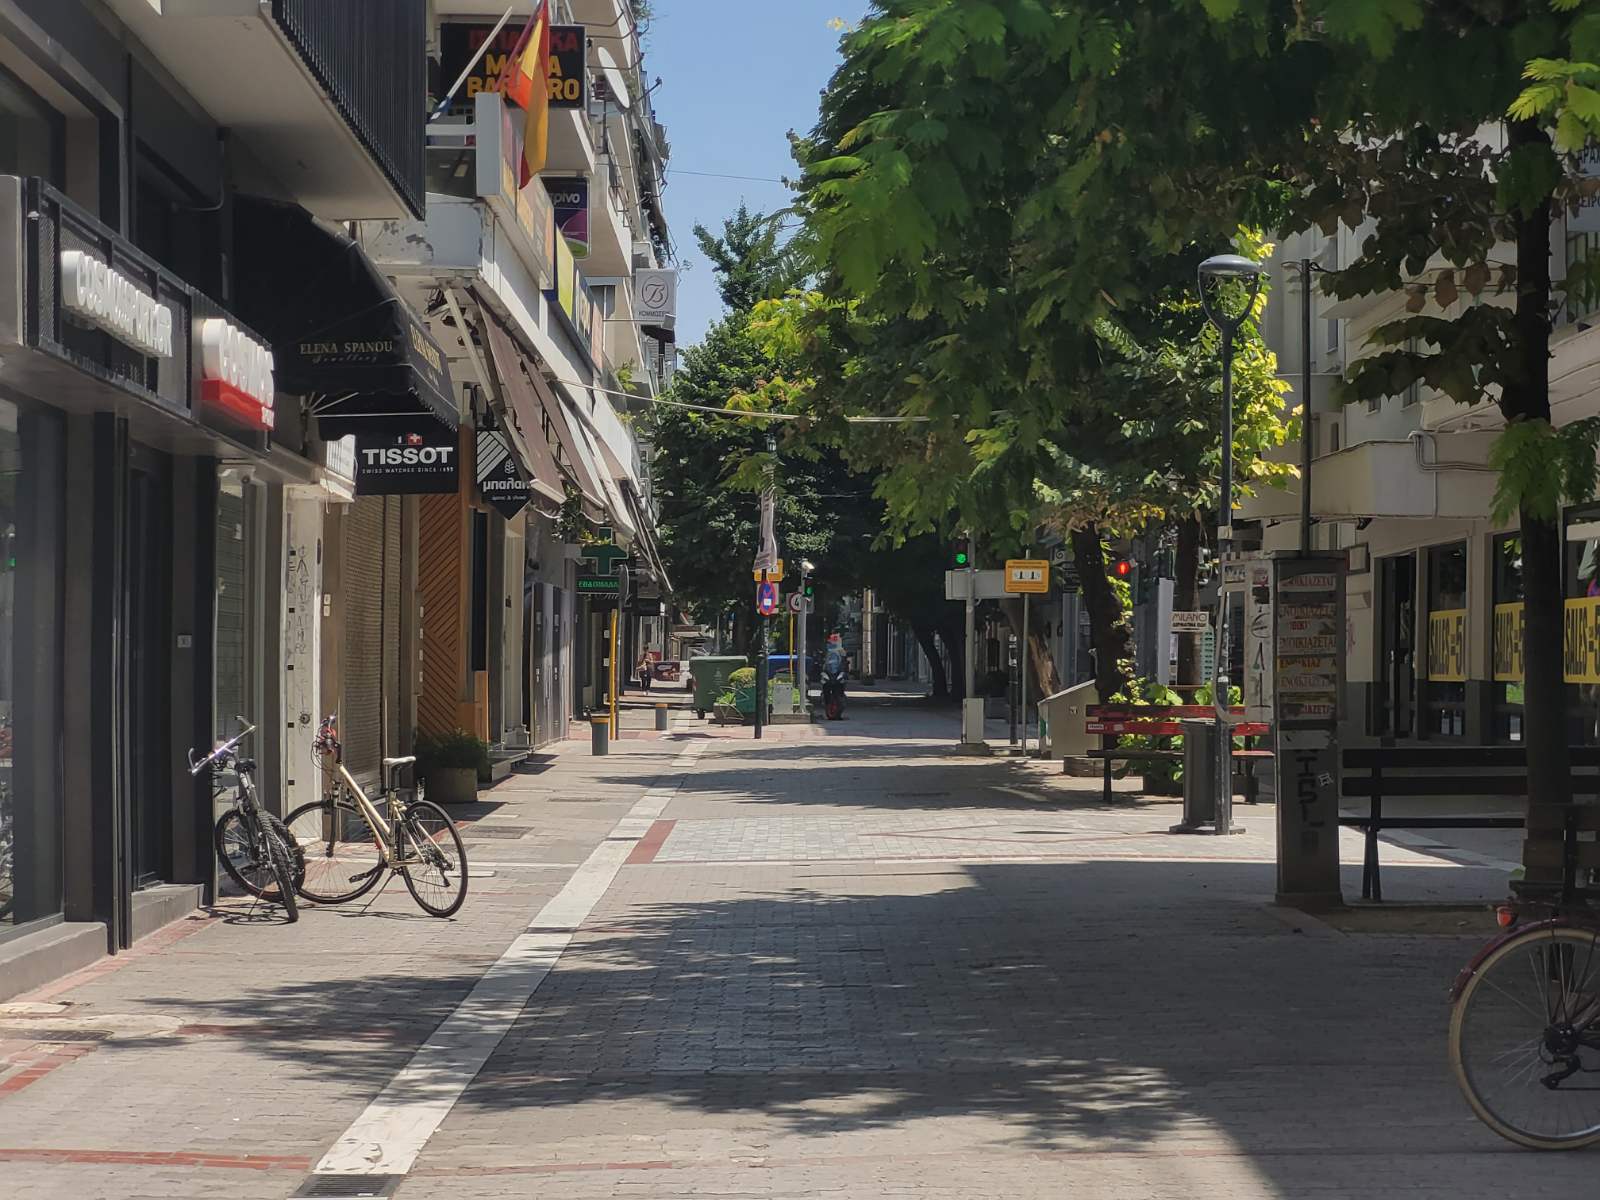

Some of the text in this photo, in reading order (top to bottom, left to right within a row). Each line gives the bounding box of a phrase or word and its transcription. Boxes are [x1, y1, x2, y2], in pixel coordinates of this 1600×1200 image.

[299, 340, 393, 355] ELENA SPANOU
[362, 446, 454, 465] TISSOT
[1172, 613, 1207, 622] MILANO
